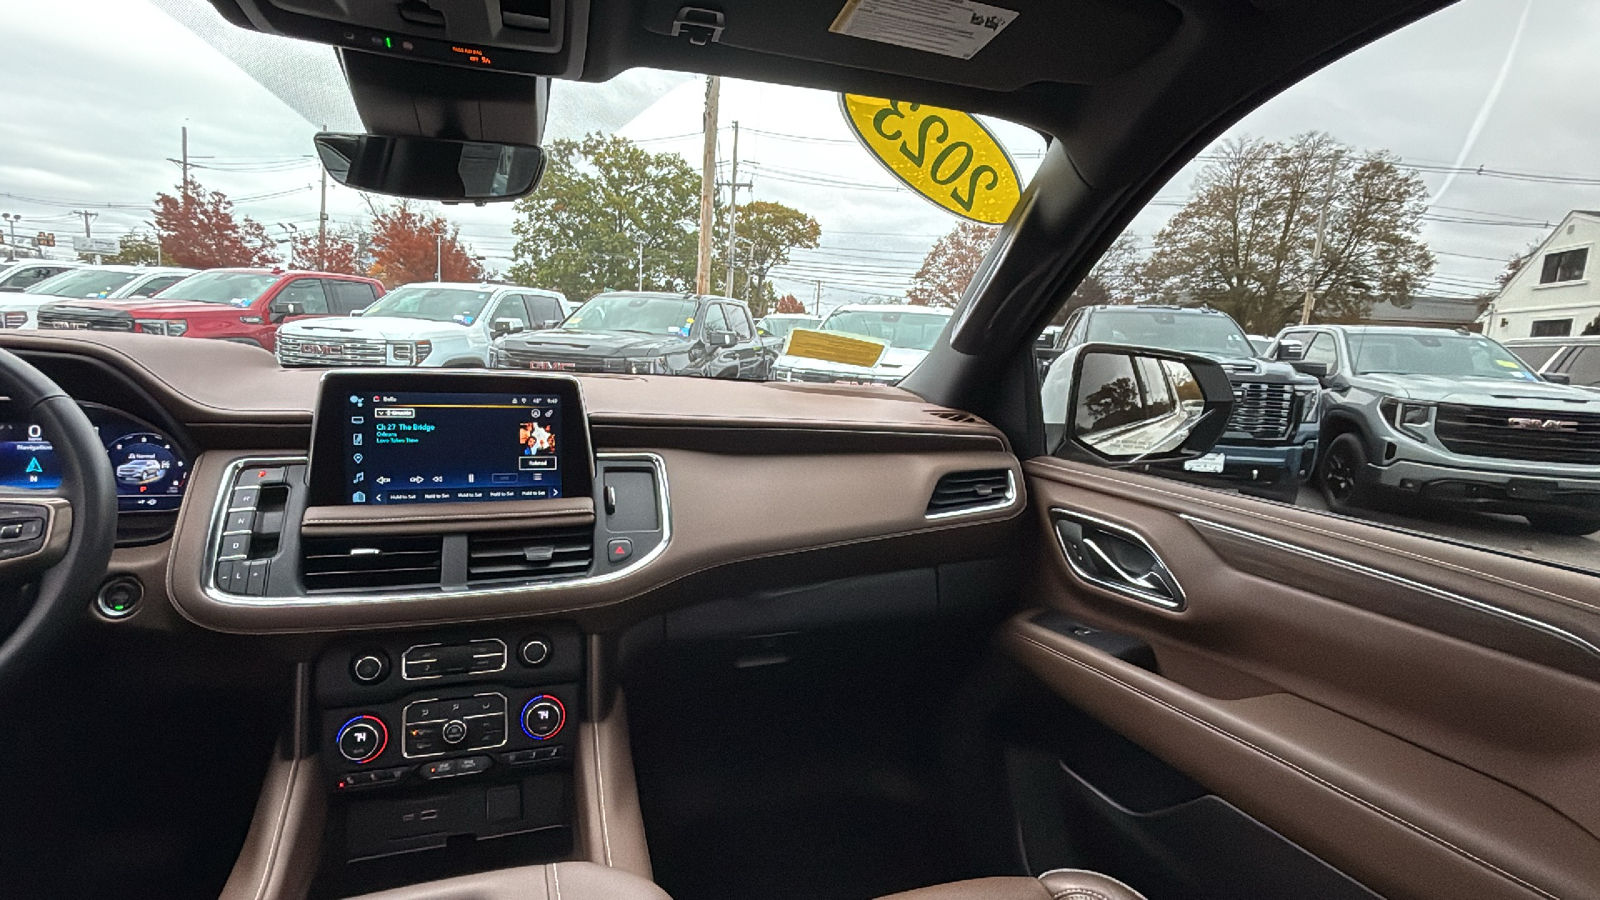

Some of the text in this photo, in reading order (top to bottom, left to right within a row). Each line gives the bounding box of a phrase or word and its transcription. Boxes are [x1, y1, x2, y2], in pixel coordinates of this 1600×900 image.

[300, 343, 344, 356] GMC
[530, 360, 576, 370] GMC
[413, 424, 436, 432] Bridge
[1508, 417, 1578, 432] GMC
[30, 474, 38, 482] N
[258, 470, 266, 478] P
[538, 710, 549, 720] 74
[354, 732, 366, 742] 74
